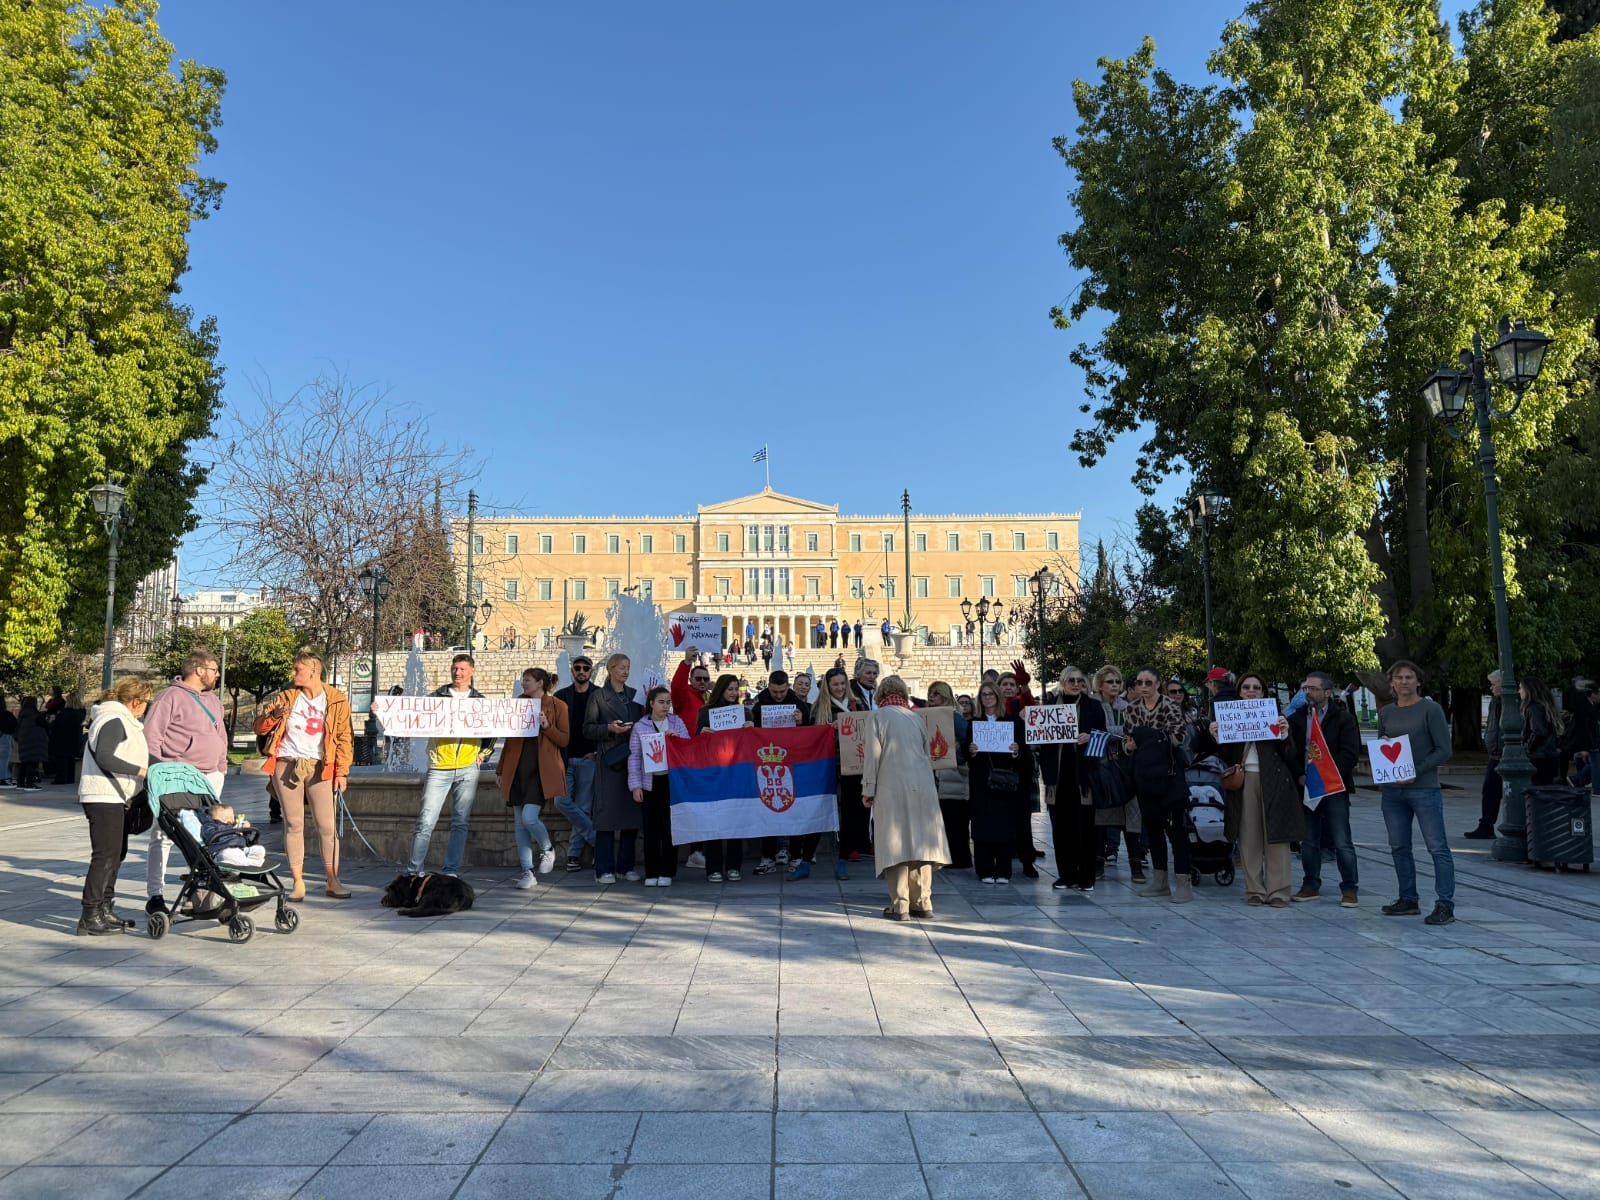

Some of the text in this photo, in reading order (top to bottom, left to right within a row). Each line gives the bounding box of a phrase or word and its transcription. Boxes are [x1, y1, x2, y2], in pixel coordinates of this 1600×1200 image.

[678, 615, 700, 623] RUKE
[383, 698, 396, 712] У
[399, 697, 444, 713] ДЕЦИ
[382, 716, 393, 730] И
[396, 712, 446, 729] ЧИСТИ
[1029, 707, 1066, 725] РУКЕ
[1026, 724, 1079, 743] ВАМ КРВАВЕ
[1375, 767, 1391, 782] ЗА
